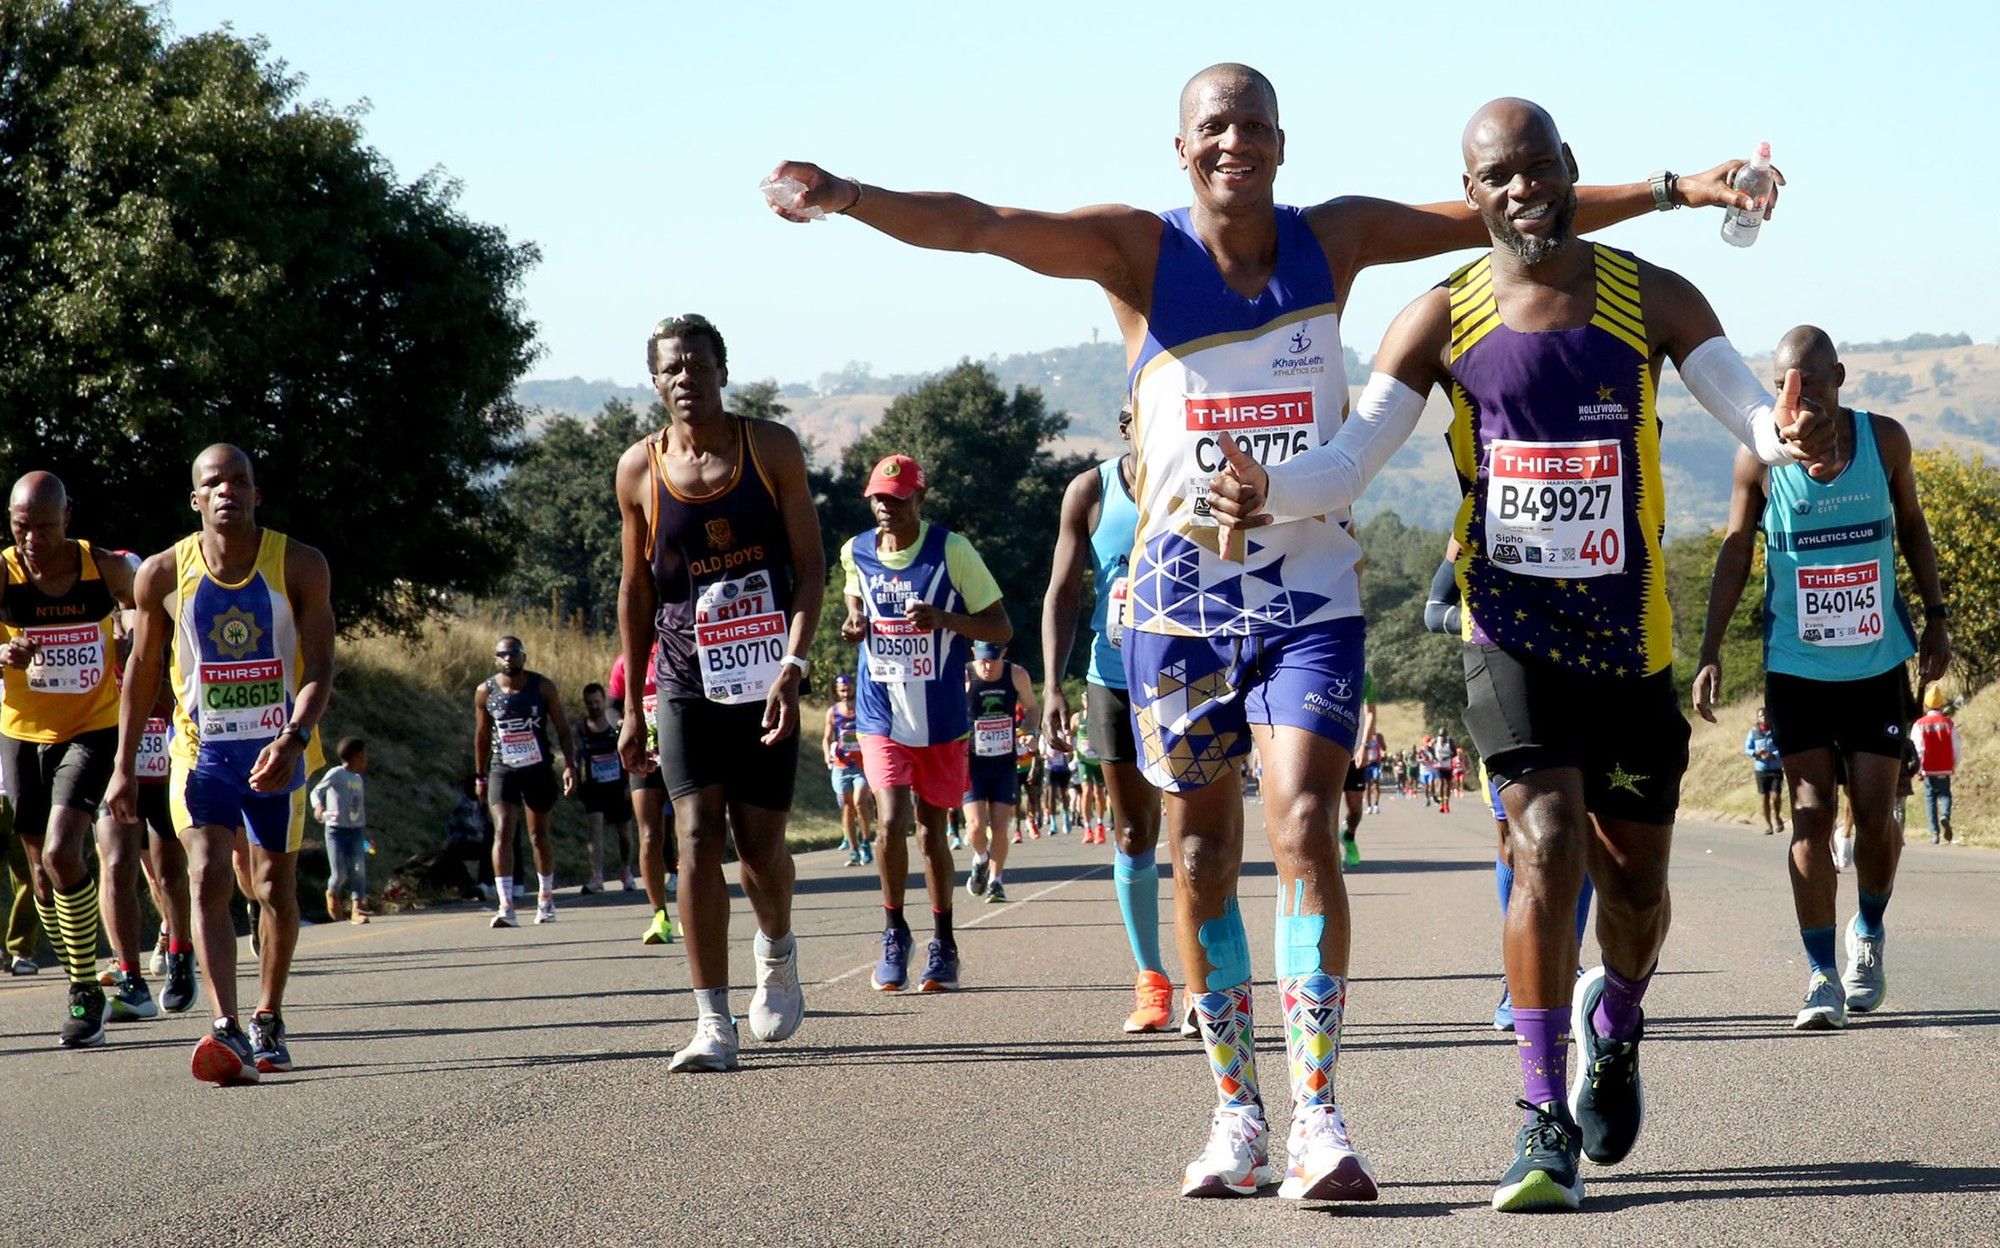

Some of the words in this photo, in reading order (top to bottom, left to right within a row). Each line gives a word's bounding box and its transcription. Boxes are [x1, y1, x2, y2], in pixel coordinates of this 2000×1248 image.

[1193, 402, 1303, 424] THIRSTI
[1501, 455, 1608, 473] THIRSTI
[1500, 484, 1612, 522] B49927
[1495, 533, 1523, 544] Sipho
[1797, 532, 1848, 545] ATHLETICS
[1849, 528, 1874, 539] CLUB
[1496, 546, 1518, 556] ASA
[1579, 528, 1619, 566] 40
[691, 556, 721, 576] OLD
[724, 546, 764, 568] BOYS
[1548, 553, 1556, 562] 2
[1804, 570, 1872, 585] THIRSTI
[1805, 586, 1875, 614] B40145
[703, 620, 777, 641] THIRSTI
[1858, 612, 1881, 636] 40
[31, 631, 94, 643] THIRSTI
[877, 637, 928, 655] D35010
[33, 646, 97, 667] D55862
[707, 638, 783, 672] B30710
[205, 666, 277, 680] THIRSTI
[913, 658, 932, 677] 50
[80, 668, 100, 688] 50
[207, 682, 280, 709] C48613
[260, 706, 284, 729] 40
[147, 756, 166, 771] 40
